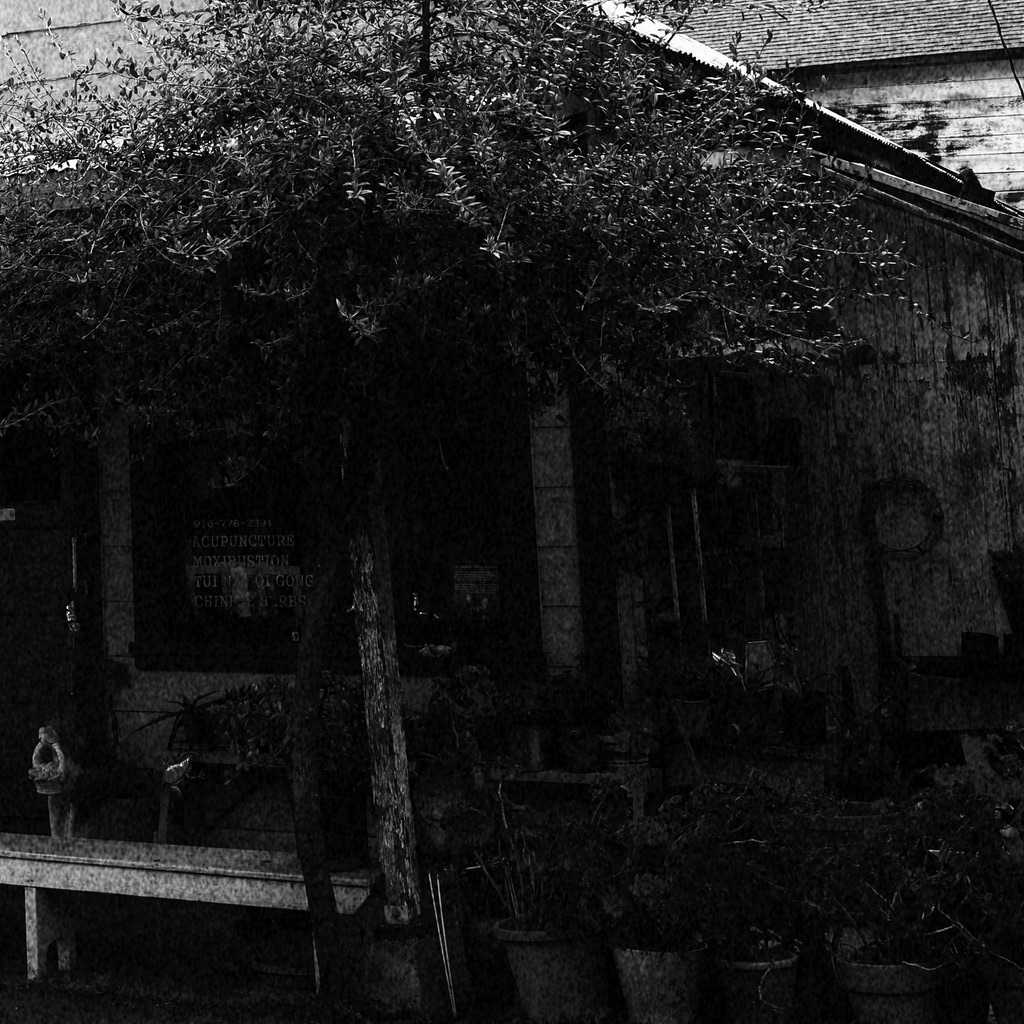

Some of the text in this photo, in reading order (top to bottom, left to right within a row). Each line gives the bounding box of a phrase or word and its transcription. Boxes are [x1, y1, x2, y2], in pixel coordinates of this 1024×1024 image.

[193, 519, 273, 529] 916-776-2391
[192, 534, 296, 547] ACUPUNCTURE
[195, 574, 219, 588] TUI
[255, 574, 273, 589] QI
[275, 574, 314, 588] GONG
[259, 594, 306, 608] HRBS
